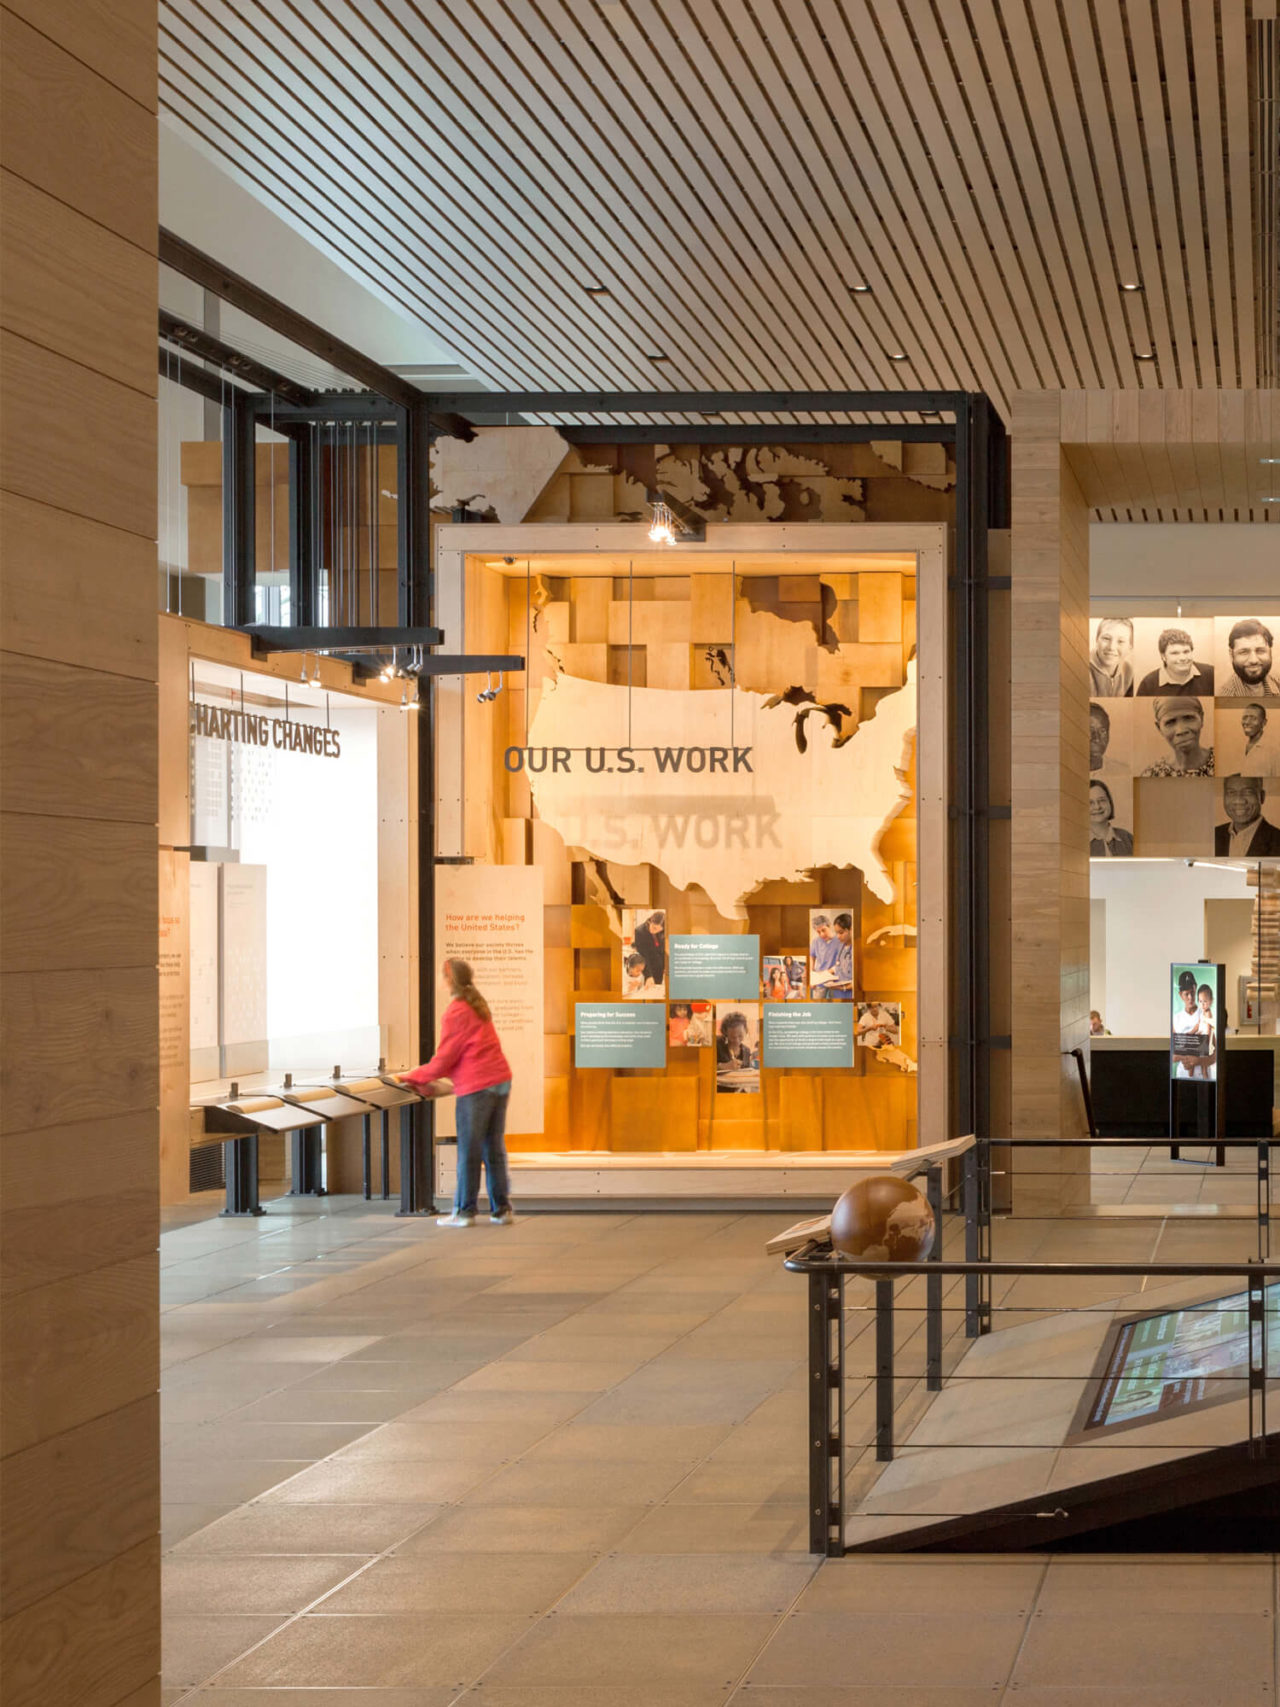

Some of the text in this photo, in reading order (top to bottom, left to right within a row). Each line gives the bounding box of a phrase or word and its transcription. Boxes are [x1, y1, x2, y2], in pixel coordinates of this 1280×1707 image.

[273, 718, 341, 758] CHANGES
[504, 746, 754, 773] OUR U.S. WORK
[494, 914, 525, 923] helping
